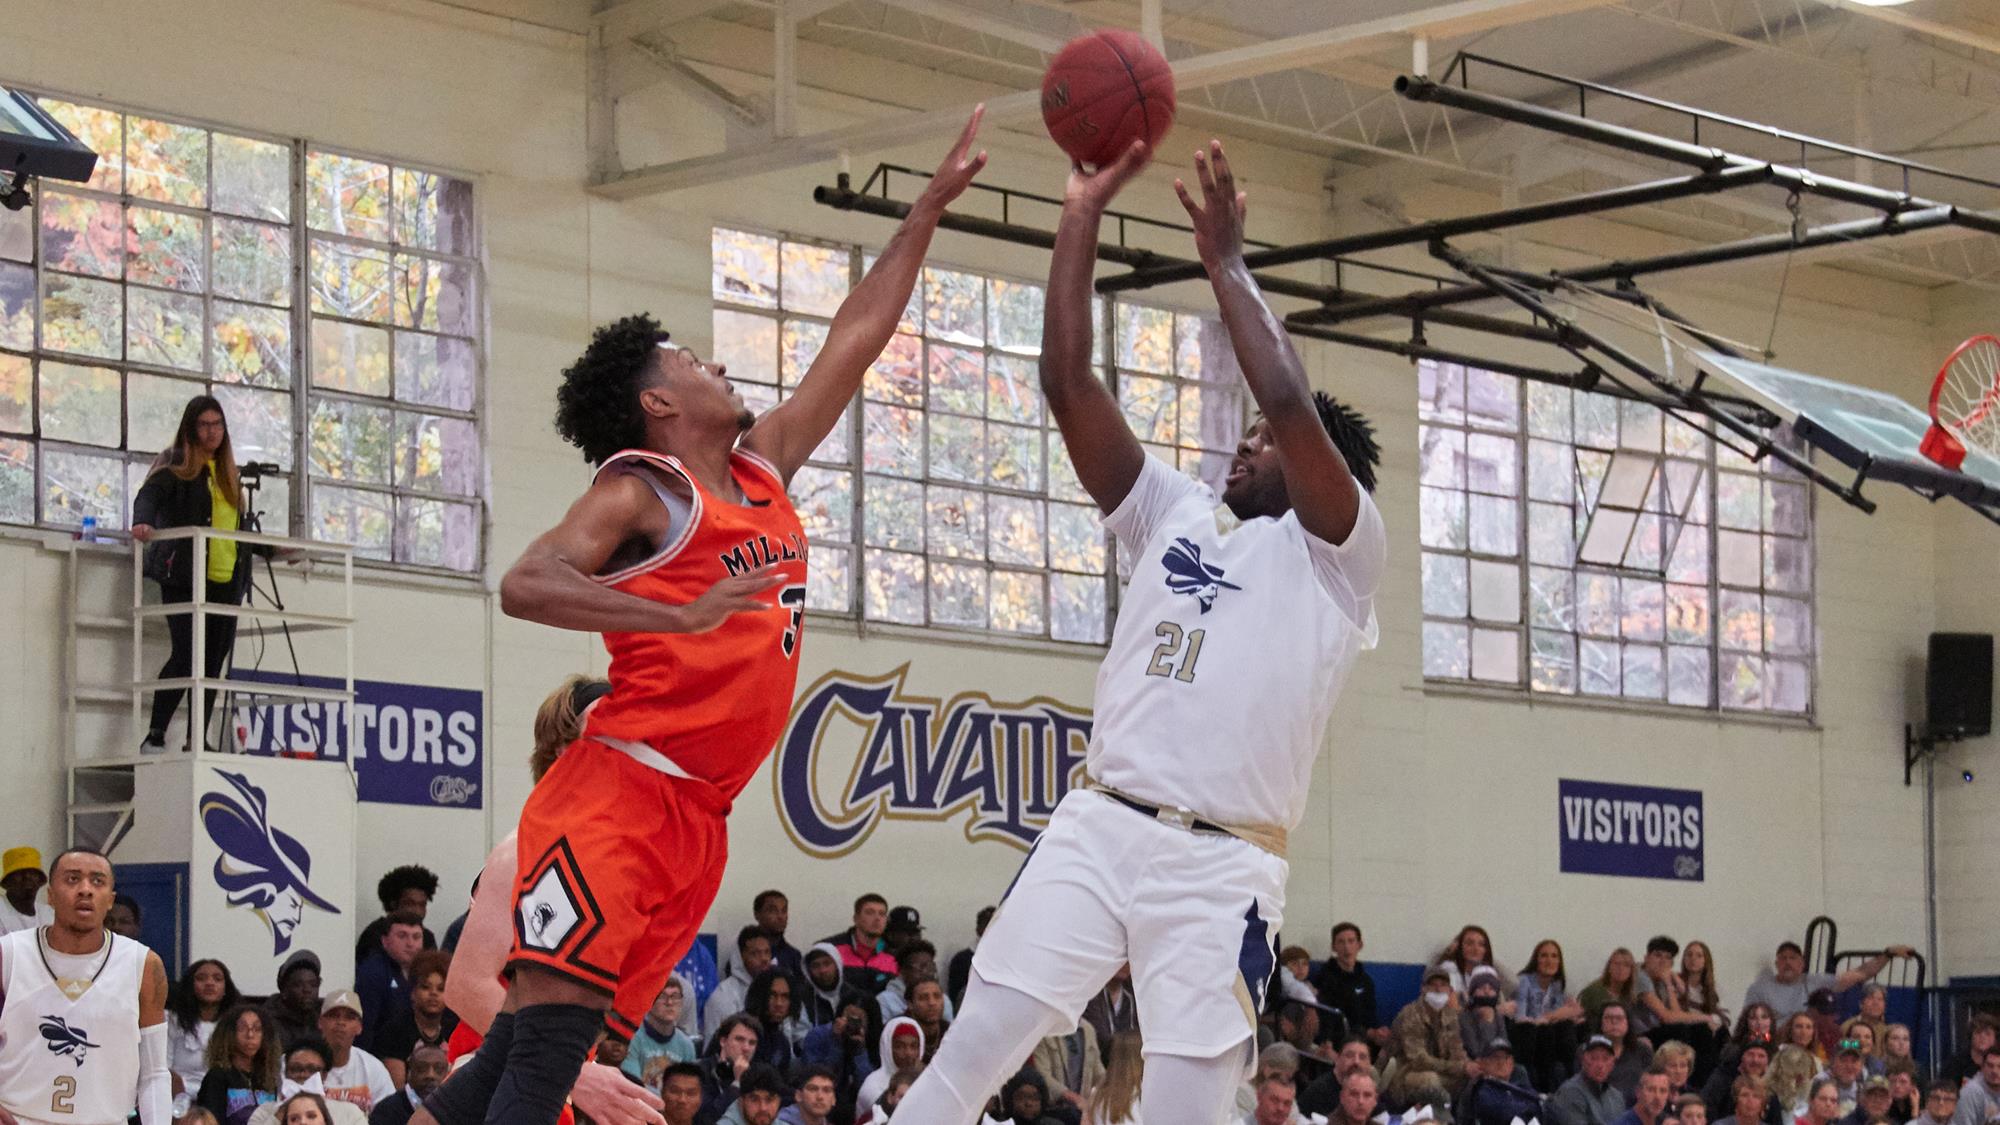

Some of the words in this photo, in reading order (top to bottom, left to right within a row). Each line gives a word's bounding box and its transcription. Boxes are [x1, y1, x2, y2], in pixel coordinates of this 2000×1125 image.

[720, 534, 808, 576] MILLI
[1146, 620, 1206, 683] 21
[234, 692, 476, 767] VISITORS
[1563, 796, 1700, 849] VISITORS
[52, 1075, 77, 1113] 2
